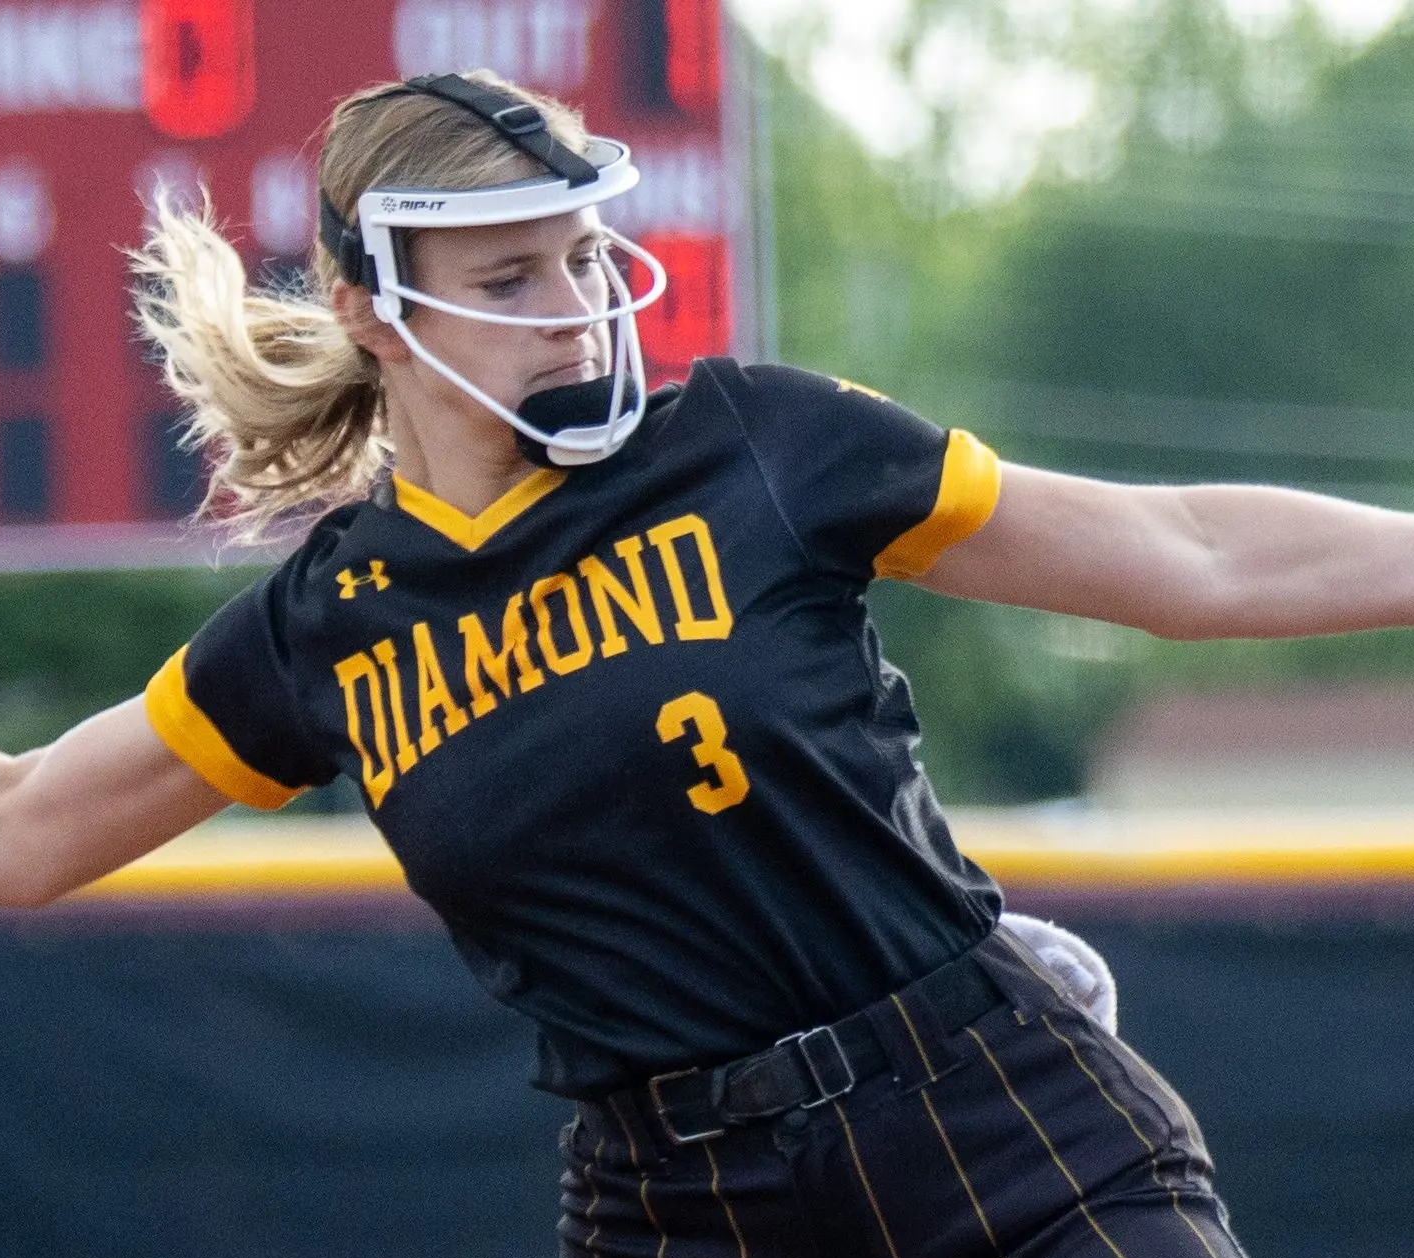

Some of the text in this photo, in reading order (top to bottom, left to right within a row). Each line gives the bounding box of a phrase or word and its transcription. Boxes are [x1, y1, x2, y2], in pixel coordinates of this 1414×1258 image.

[398, 200, 447, 212] RIP-IT
[333, 512, 736, 810] DIAMOND
[655, 690, 751, 816] 3
